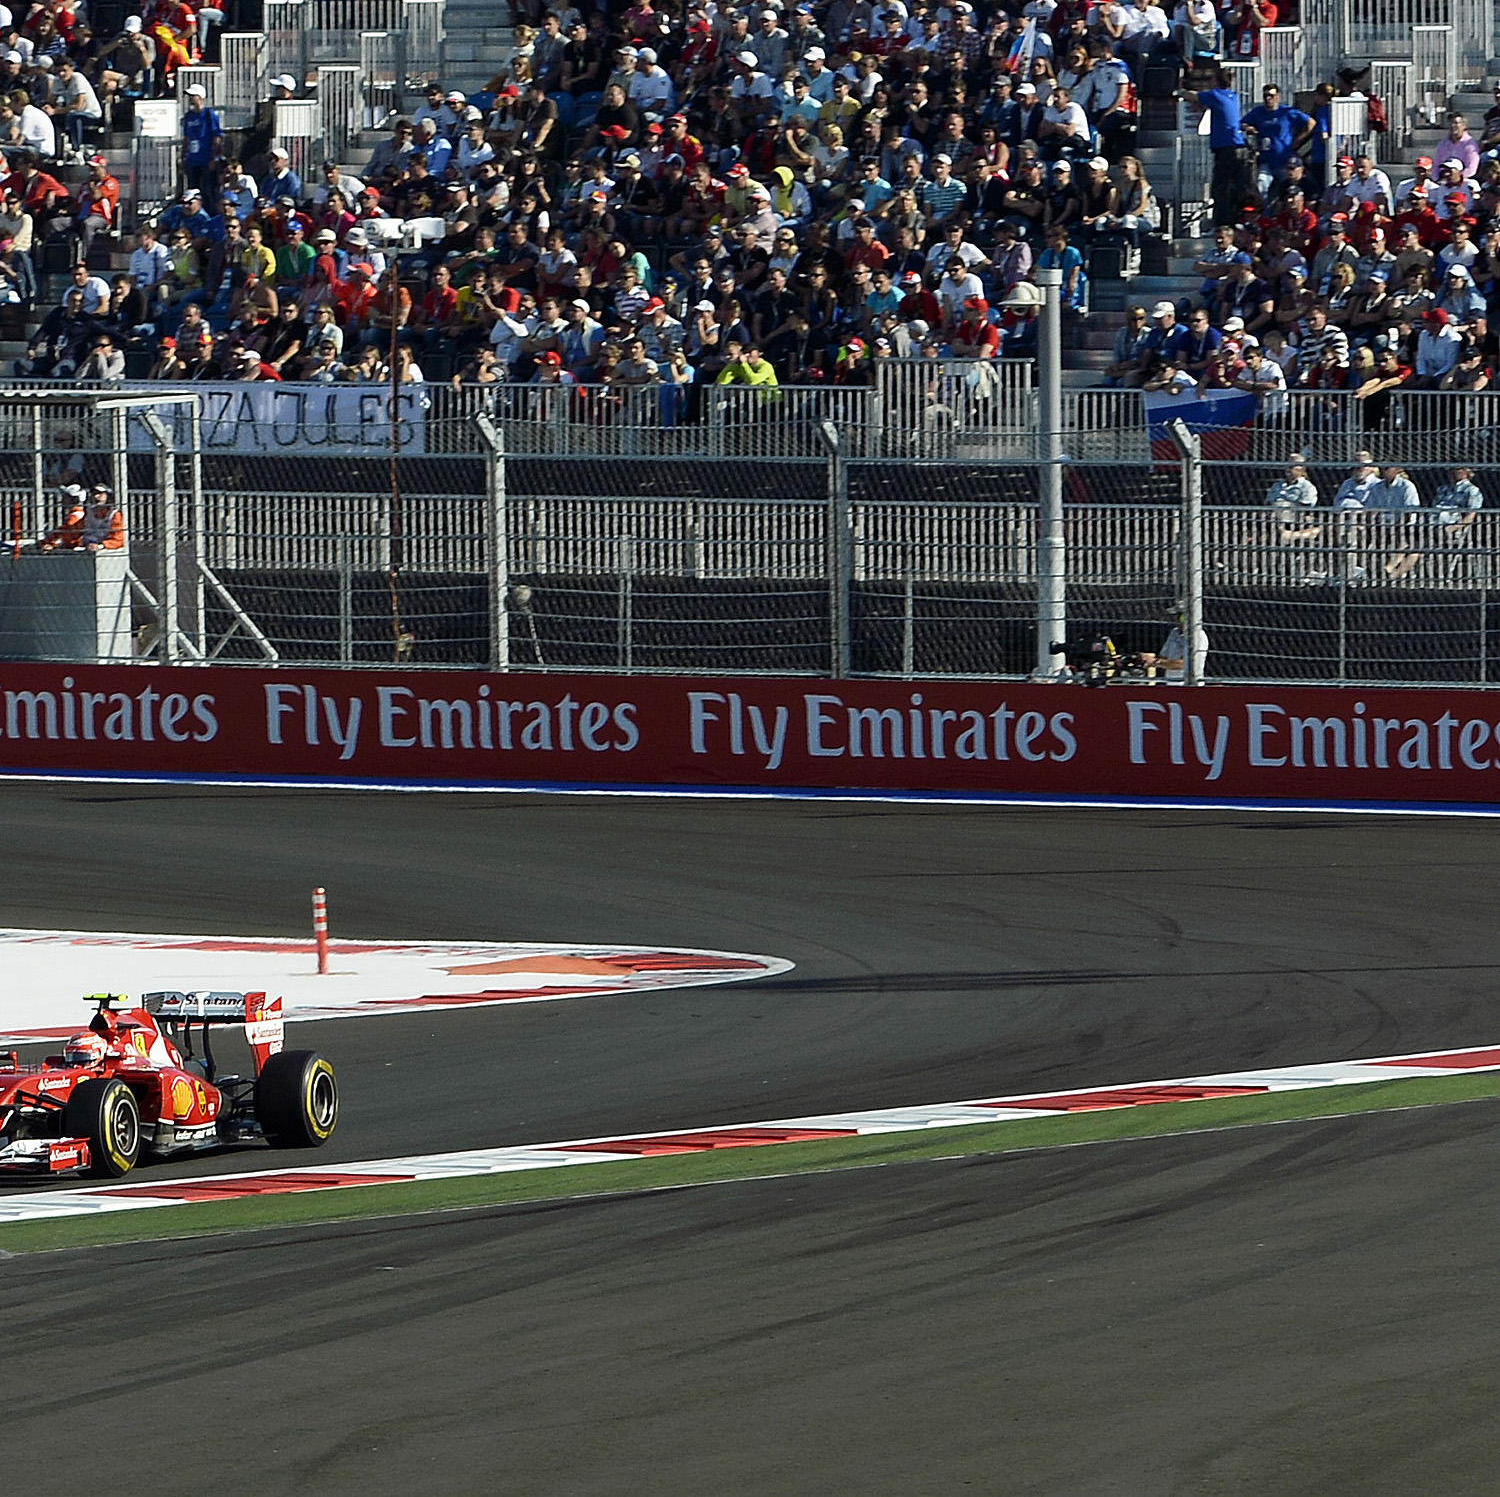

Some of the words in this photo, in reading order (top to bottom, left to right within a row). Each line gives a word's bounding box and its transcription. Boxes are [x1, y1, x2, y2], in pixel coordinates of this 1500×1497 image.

[273, 390, 415, 447] JULES
[264, 683, 362, 760] Fly
[376, 684, 639, 752] Emirates
[687, 692, 788, 770] Fly
[803, 693, 1077, 762] Emirates
[1126, 701, 1229, 780] Fly
[1245, 701, 1500, 771] Emirate
